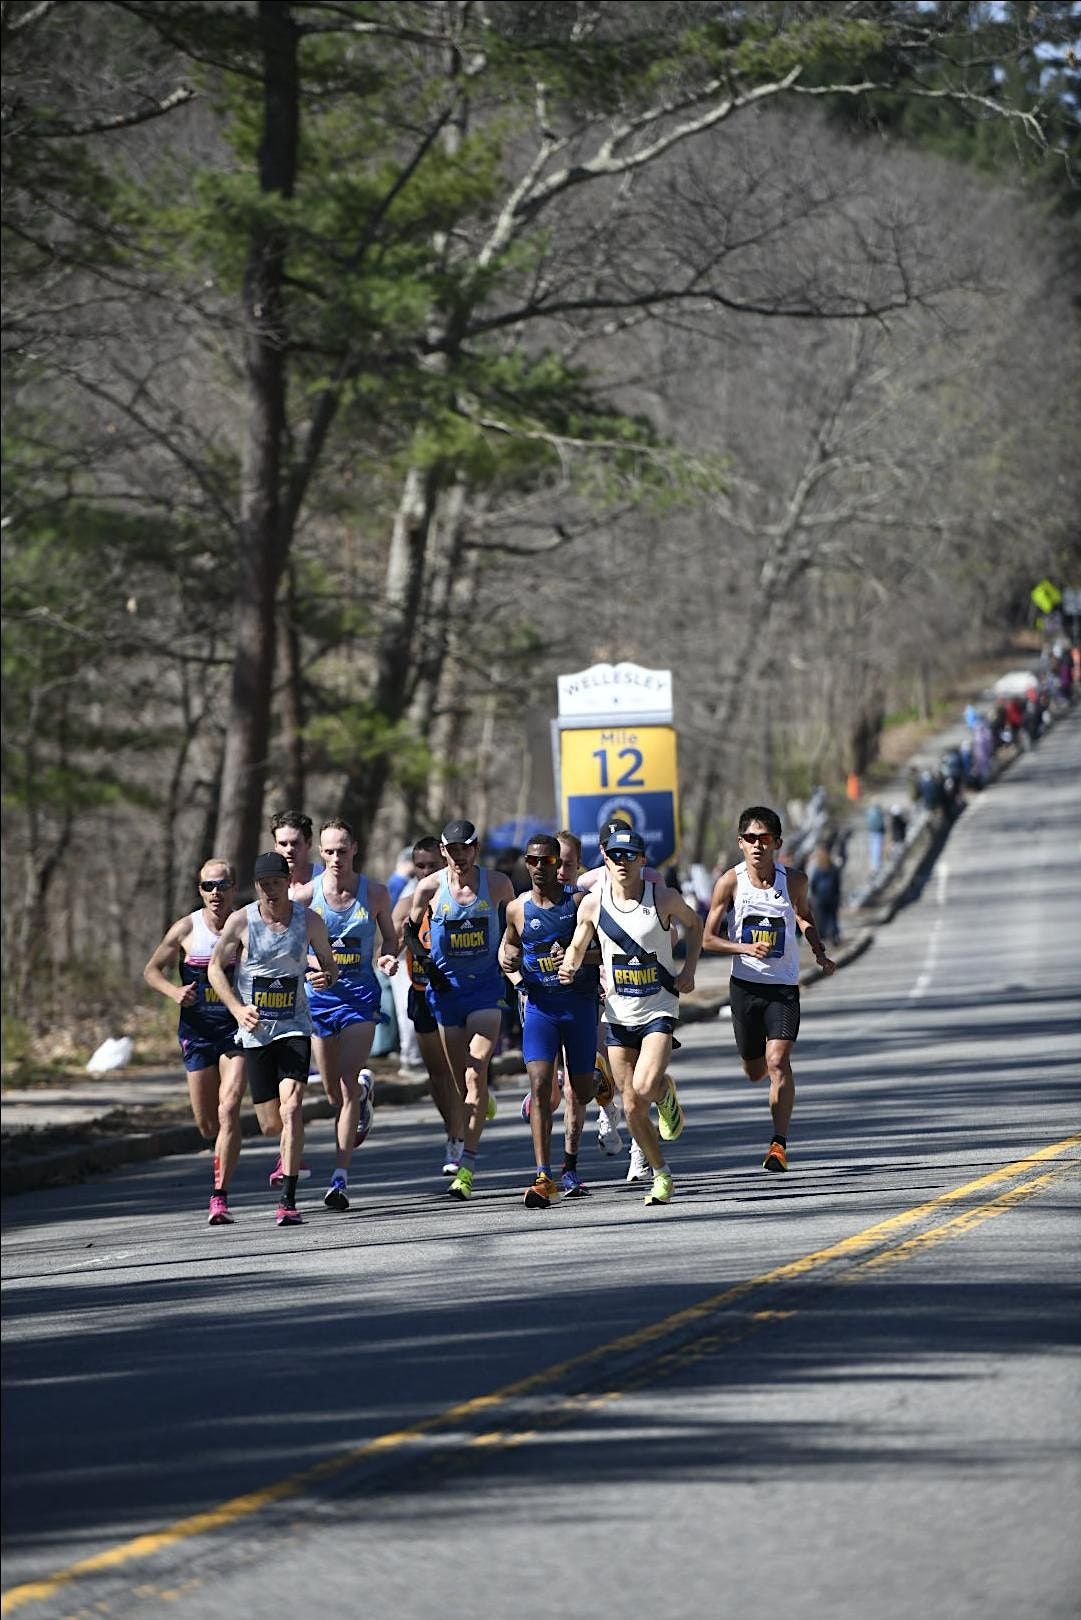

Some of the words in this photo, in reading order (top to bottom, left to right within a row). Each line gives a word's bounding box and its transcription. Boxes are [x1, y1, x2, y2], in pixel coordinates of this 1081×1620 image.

[563, 671, 665, 697] WELLESLEY
[601, 730, 638, 746] Mile
[593, 748, 645, 788] 12
[450, 930, 485, 949] MOCK
[751, 929, 777, 946] YUKI
[614, 967, 658, 986] BENNIE
[254, 990, 295, 1008] FAUBLE
